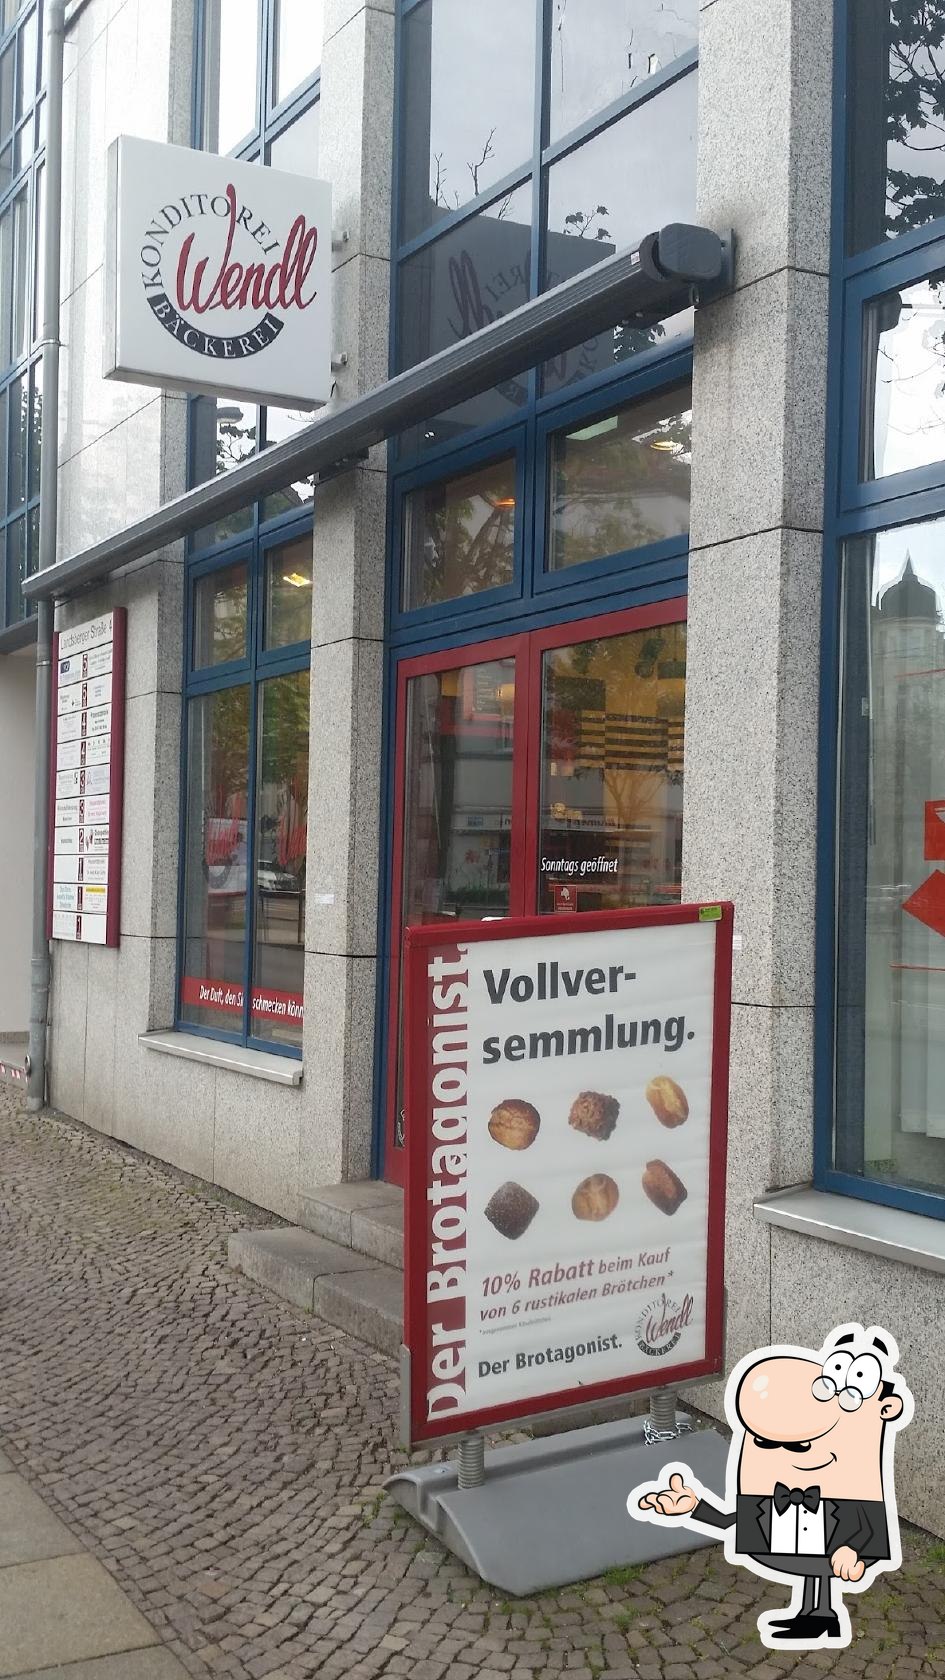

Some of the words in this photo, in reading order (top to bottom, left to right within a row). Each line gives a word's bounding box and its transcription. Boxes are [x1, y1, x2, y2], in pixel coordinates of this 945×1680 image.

[140, 194, 280, 291] KONDITOREI
[176, 183, 318, 315] Wendl
[153, 302, 280, 358] BÄCKEREI
[540, 857, 579, 876] Sonntags
[580, 856, 618, 876] geöffnet
[200, 985, 210, 1000] Der
[210, 987, 224, 1006] Duft,
[225, 988, 237, 1006] den
[252, 994, 287, 1016] schmecken
[287, 999, 304, 1019] könn
[483, 961, 637, 1005] Vollver-
[482, 1013, 695, 1064] semmlung.
[426, 943, 469, 1304] Brotagonist.
[482, 1270, 521, 1297] 10%
[528, 1260, 595, 1289] Rabatt
[598, 1256, 633, 1275] beim
[638, 1246, 671, 1268] Kauf
[480, 1306, 507, 1321] von
[511, 1300, 521, 1315] 6
[524, 1287, 597, 1312] rustikalen
[645, 1292, 694, 1344] Wendl
[426, 1322, 467, 1422] Der
[478, 1358, 510, 1378] Der
[516, 1333, 622, 1370] Brotagonist.
